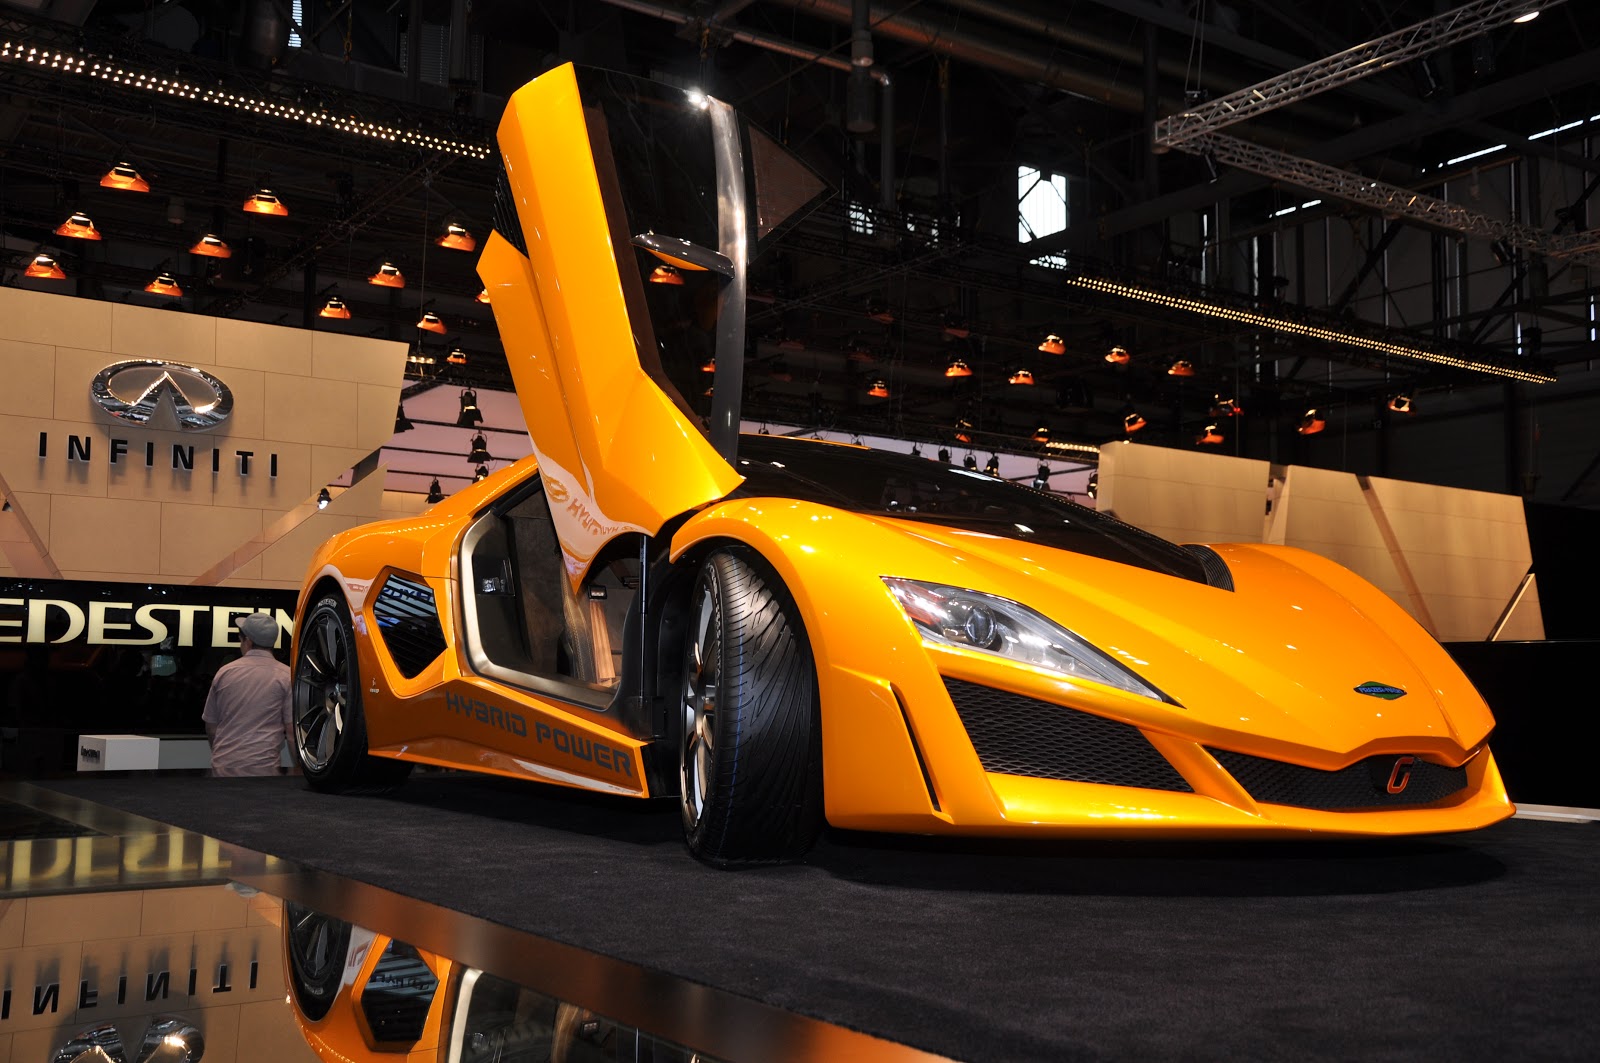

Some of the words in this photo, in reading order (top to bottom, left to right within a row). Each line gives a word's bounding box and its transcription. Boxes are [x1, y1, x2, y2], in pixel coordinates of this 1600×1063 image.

[38, 431, 278, 478] INFINITI
[0, 598, 295, 649] EDESTEN
[445, 692, 527, 737] HYBRID
[535, 722, 632, 777] POWER
